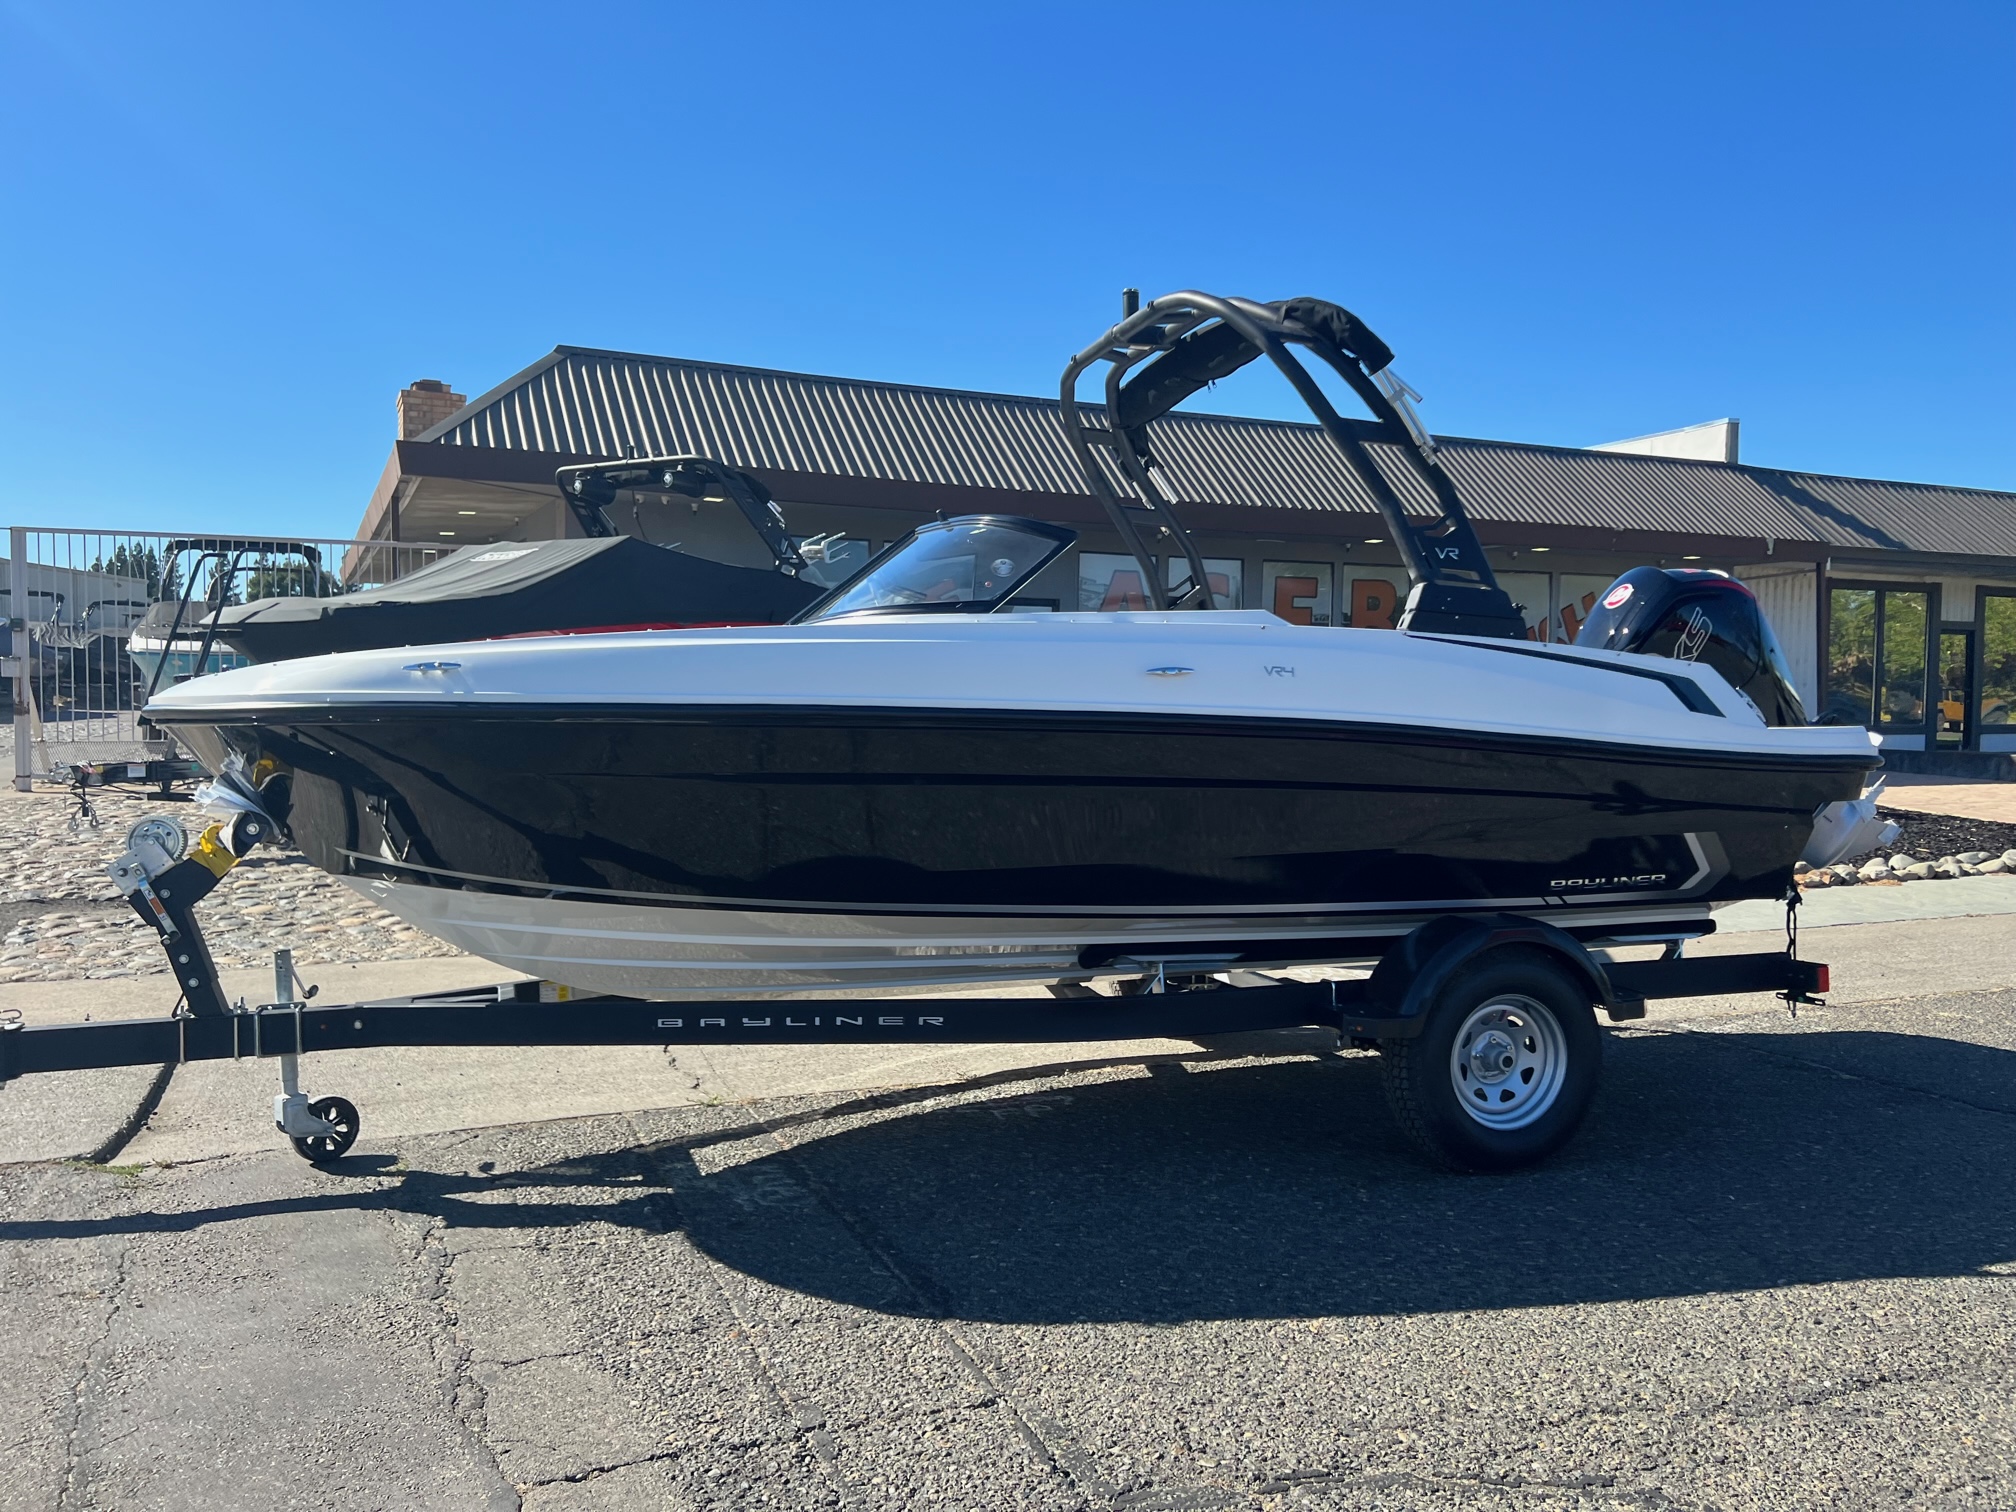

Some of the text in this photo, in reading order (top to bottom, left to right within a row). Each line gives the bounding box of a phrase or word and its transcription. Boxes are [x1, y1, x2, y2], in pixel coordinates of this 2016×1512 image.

[1434, 547, 1459, 560] VR
[1263, 665, 1295, 677] VR4
[657, 1016, 944, 1028] BAYLINER
